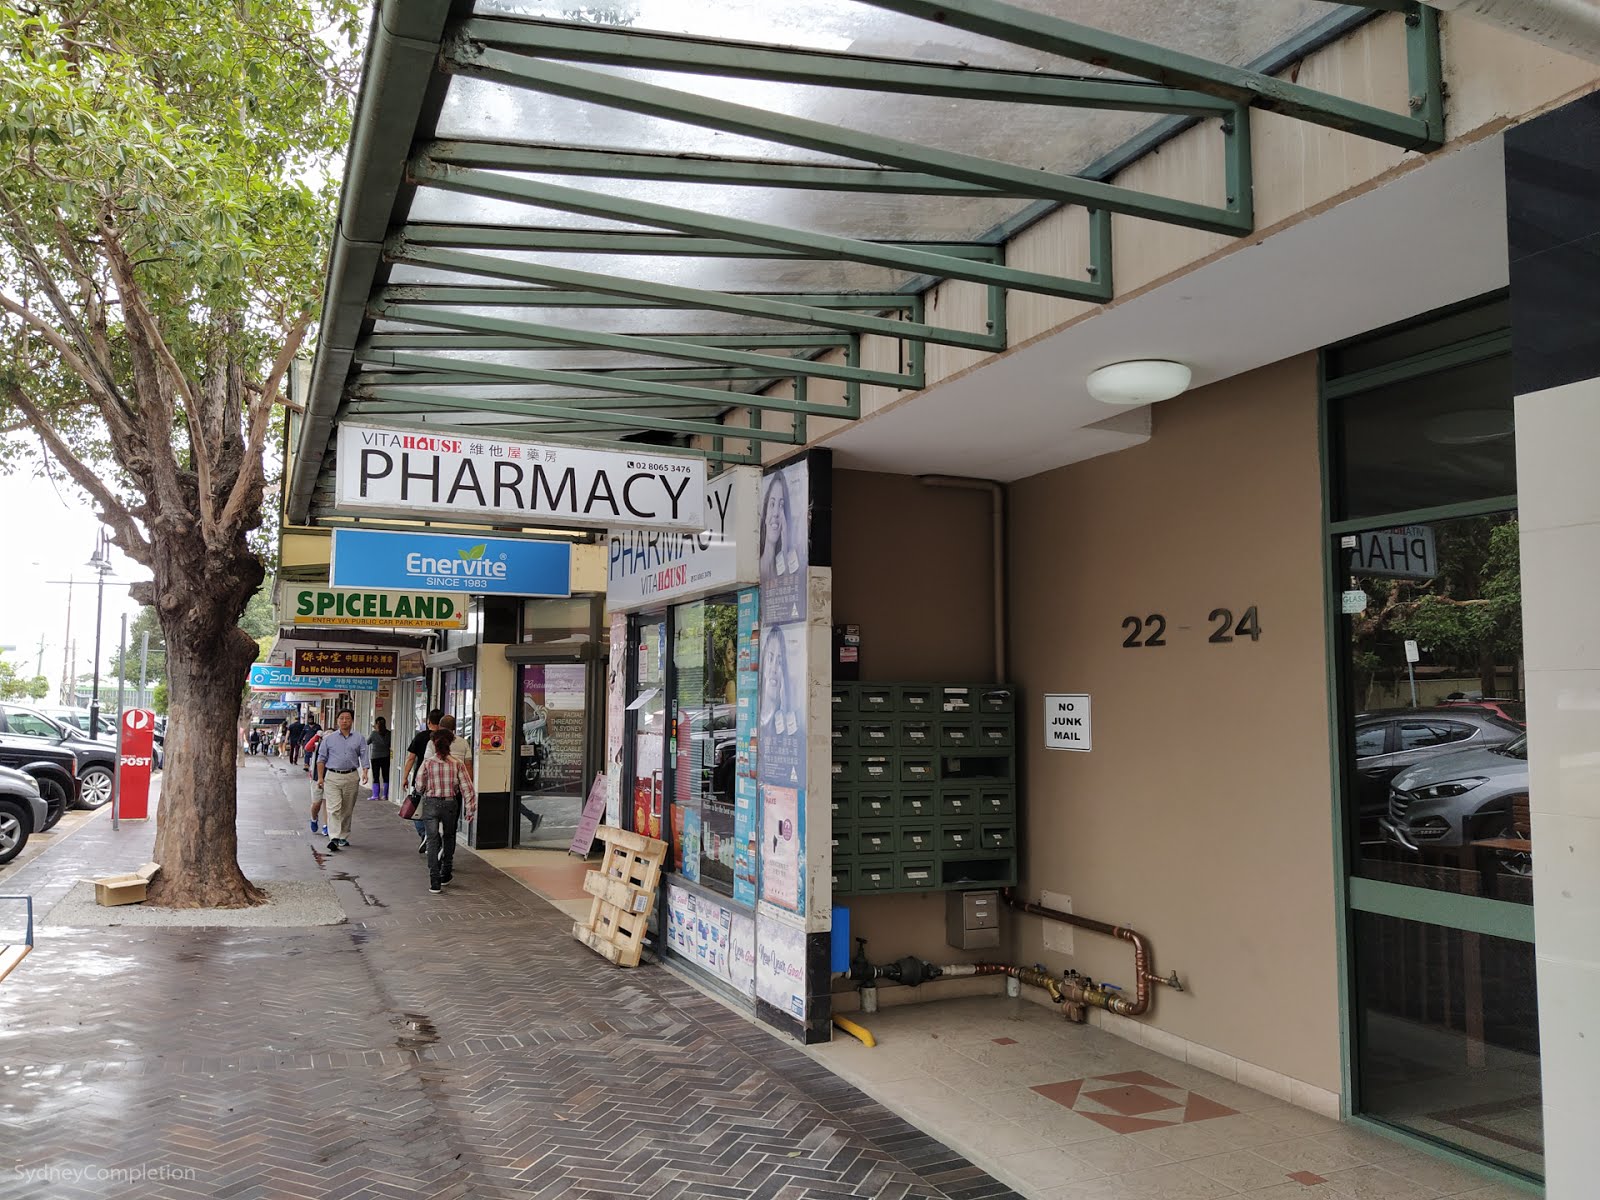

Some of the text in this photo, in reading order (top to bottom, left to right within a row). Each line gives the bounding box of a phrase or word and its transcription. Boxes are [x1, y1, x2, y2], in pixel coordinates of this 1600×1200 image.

[469, 442, 557, 463] 維他屋藥房
[635, 461, 691, 474] 02 8065 3476
[359, 448, 691, 520] PHARMACY
[405, 551, 507, 577] Enervite
[426, 577, 488, 589] SINCE 1983
[296, 590, 455, 620] SPICELAND
[395, 619, 413, 627] PARK
[1121, 613, 1167, 648] 22
[1208, 605, 1262, 643] 24
[320, 665, 345, 674] Chinese
[345, 666, 365, 674] Herbal
[366, 667, 393, 675] Medicine
[1058, 703, 1074, 712] NO
[1051, 717, 1083, 727] JUNK
[1053, 731, 1081, 741] MAIL
[120, 756, 151, 767] POST
